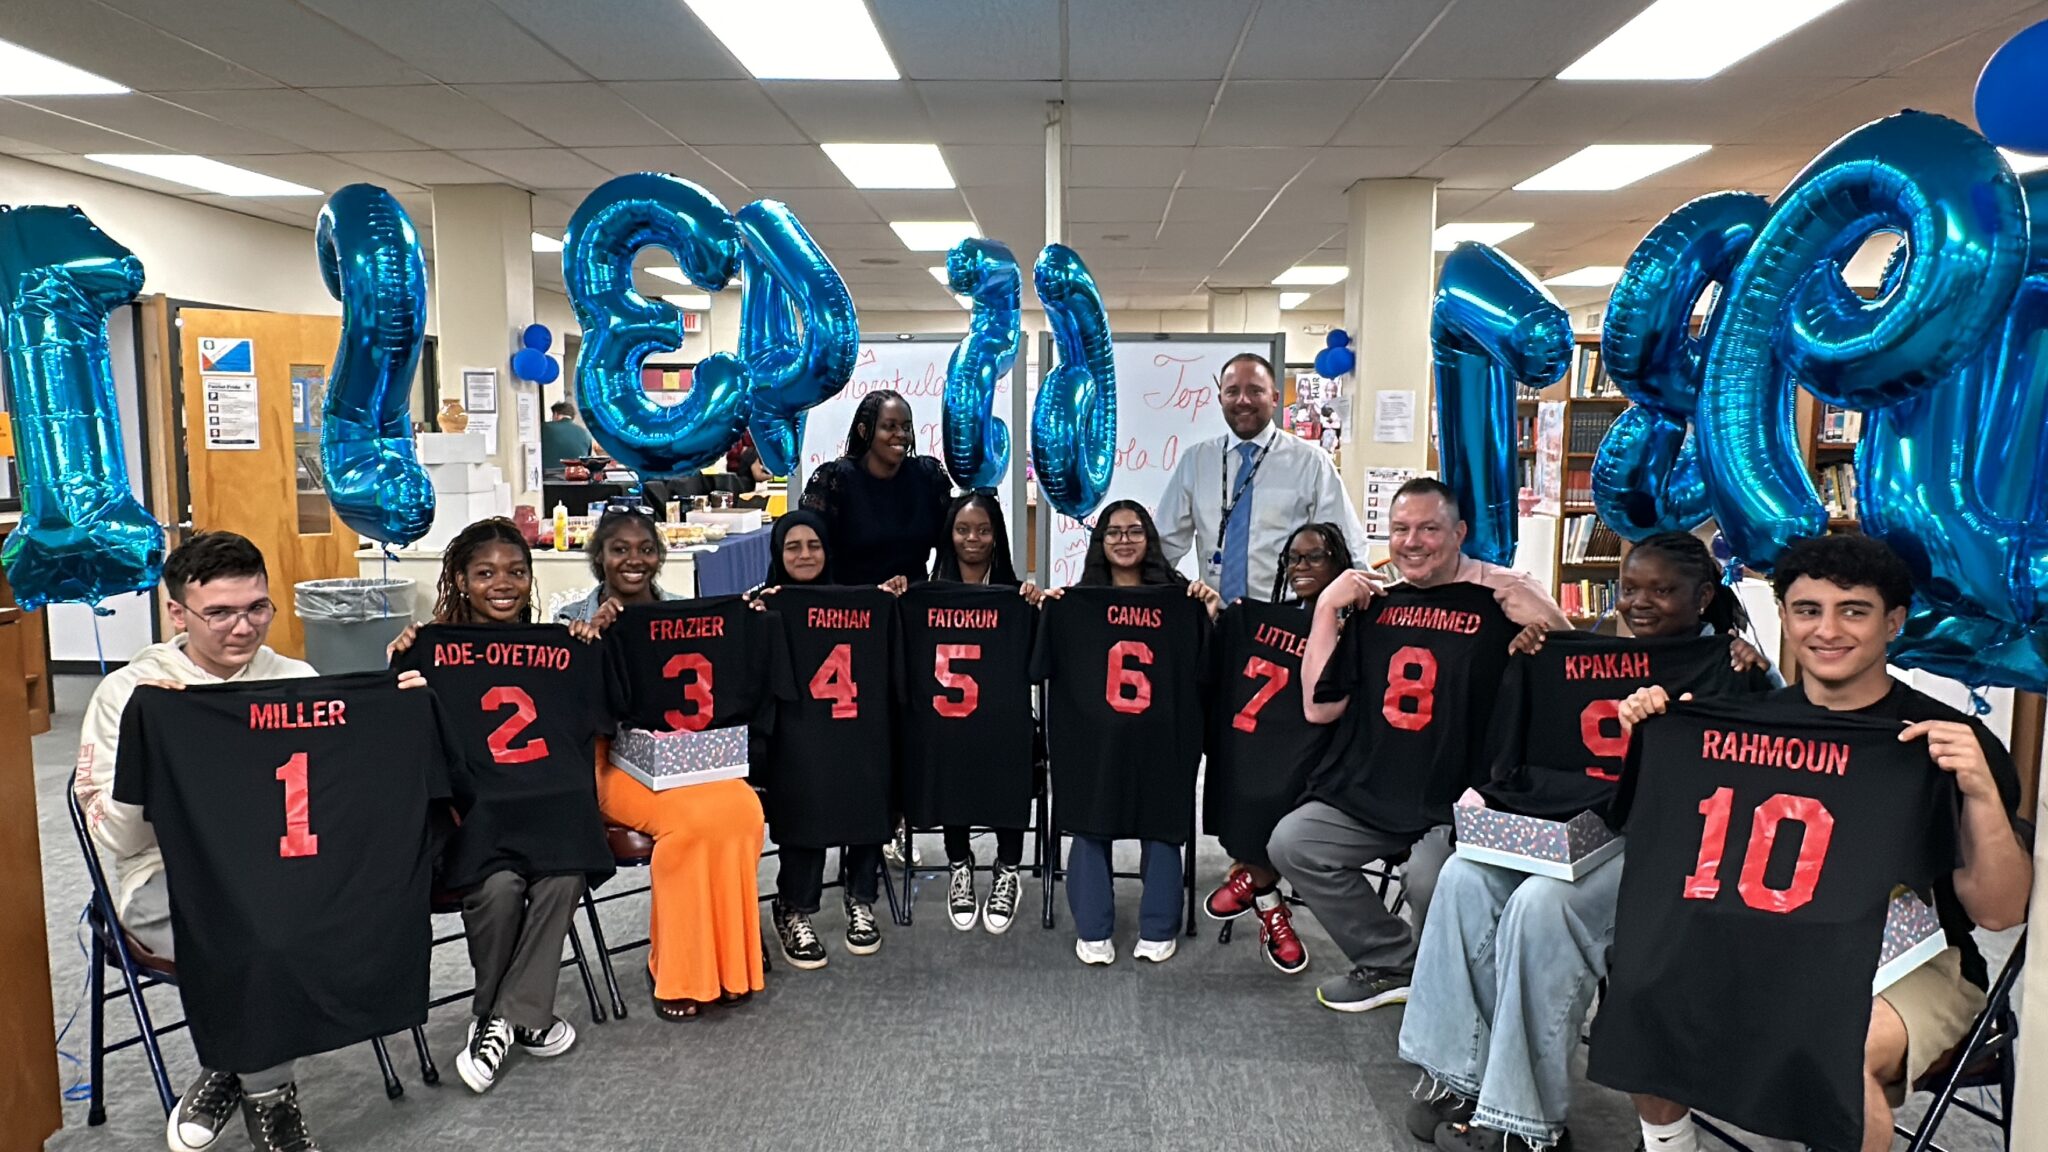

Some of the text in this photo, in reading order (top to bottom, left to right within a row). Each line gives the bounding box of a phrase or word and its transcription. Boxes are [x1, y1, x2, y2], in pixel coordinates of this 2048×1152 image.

[684, 312, 697, 329] XIT
[1142, 353, 1211, 423] Top
[650, 615, 724, 641] FRAZIER
[808, 607, 871, 629] FARHAN
[927, 607, 998, 629] FATOKUN
[1107, 605, 1162, 628] CANAS
[1254, 623, 1308, 658] LITTLE
[1376, 606, 1481, 634] MOHAMMED
[434, 642, 571, 671] ADE-OYETAYO
[809, 643, 858, 719] 4
[932, 644, 981, 718] 5
[1105, 640, 1154, 714] 6
[1564, 652, 1650, 680] KPAKAH
[250, 700, 346, 730] MILLER
[662, 652, 714, 731] 3
[1231, 655, 1290, 733] 7
[1382, 645, 1438, 731] 8
[480, 686, 550, 764] 2
[1580, 698, 1633, 782] 9
[1701, 729, 1850, 776] RAHMOUN
[276, 752, 318, 857] 1
[1683, 786, 1835, 914] 10
